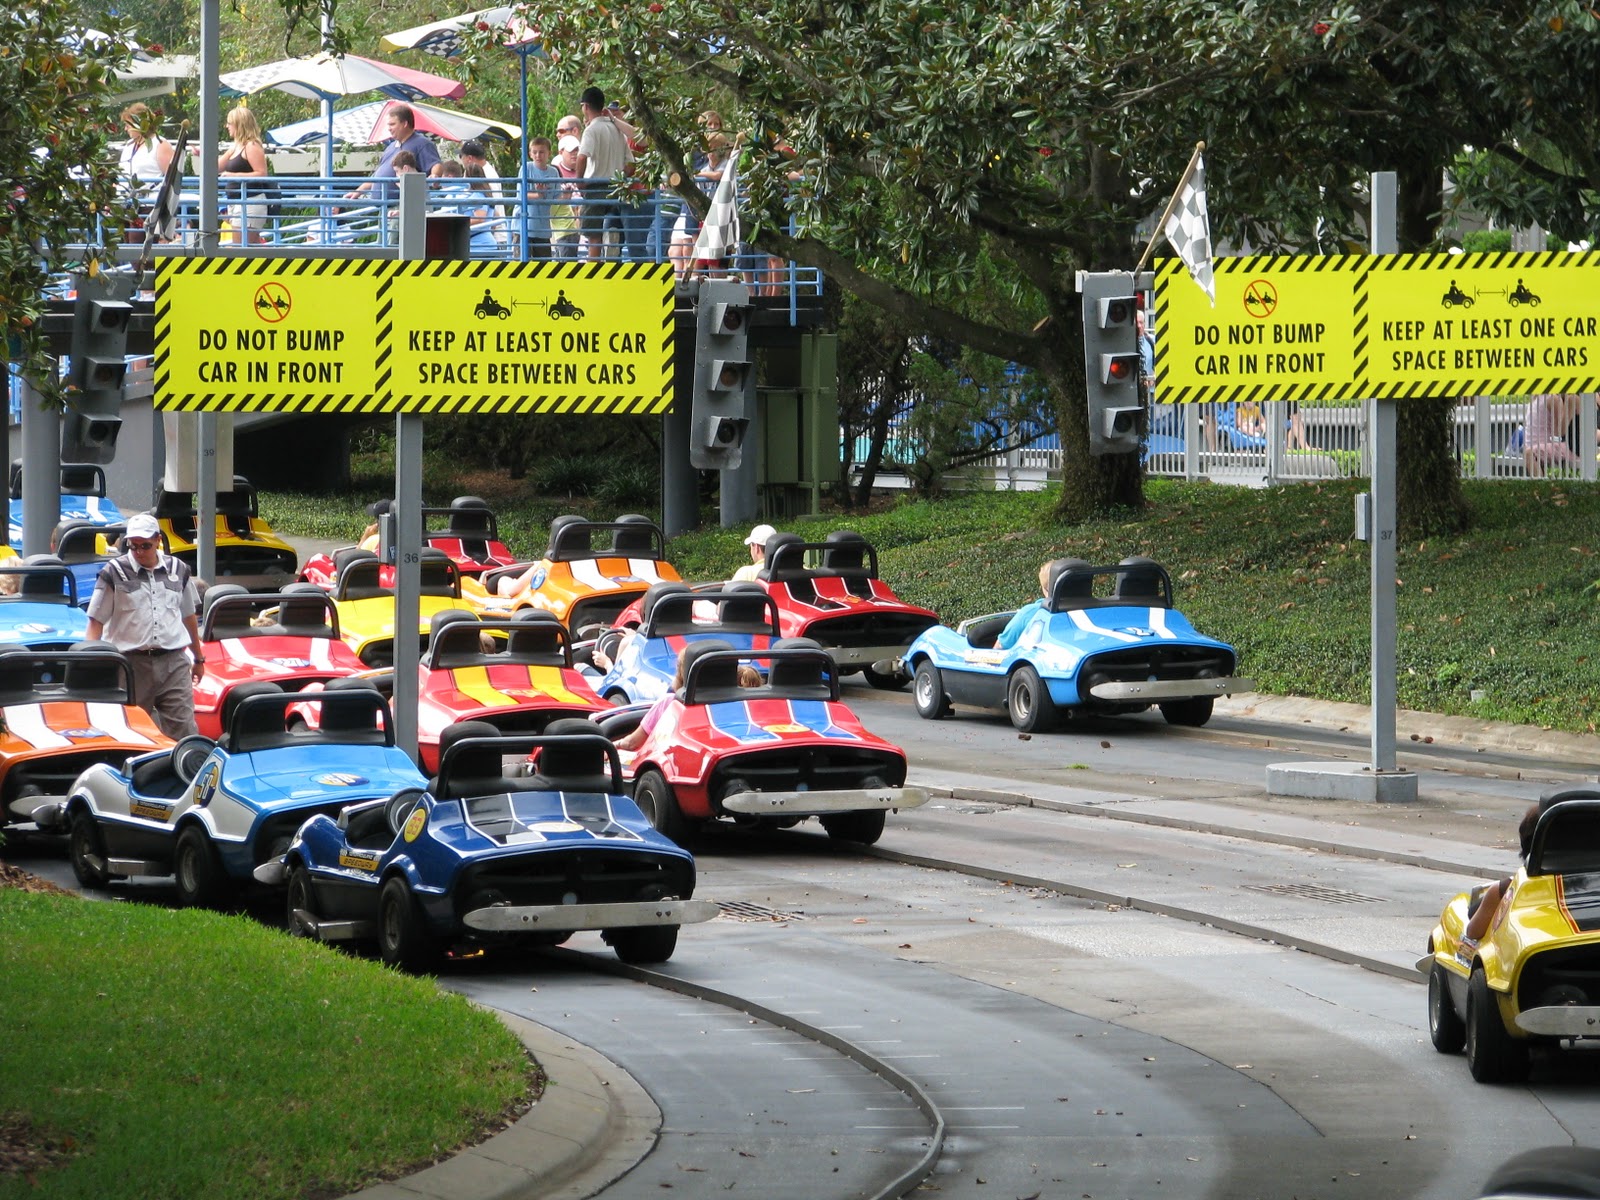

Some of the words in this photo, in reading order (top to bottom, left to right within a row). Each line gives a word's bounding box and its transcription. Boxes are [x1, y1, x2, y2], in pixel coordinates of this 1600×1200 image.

[199, 328, 228, 351] DO
[236, 329, 278, 351] NOT
[286, 329, 345, 352] BUMP
[1194, 324, 1220, 346] DO
[1228, 324, 1265, 345] NOT
[1273, 323, 1326, 344] BUMP
[1383, 320, 1425, 342] KEEP
[1433, 320, 1454, 340] AT
[1461, 318, 1513, 340] LEAST
[1520, 317, 1555, 338] ONE
[1563, 317, 1597, 337] CAR
[408, 330, 456, 352] KEEP
[464, 330, 488, 352] AT
[496, 331, 553, 353] LEAST
[560, 331, 600, 353] ONE
[608, 332, 647, 354] CAR
[1194, 354, 1230, 376] CAR
[1239, 354, 1258, 375] IN
[1266, 352, 1326, 374] FRONT
[1392, 350, 1446, 371] SPACE
[1454, 347, 1535, 370] BETWEEN
[1542, 346, 1588, 367] CARS
[198, 361, 238, 383] CAR
[247, 361, 268, 383] IN
[277, 361, 344, 384] FRONT
[418, 362, 478, 384] SPACE
[487, 363, 577, 385] BETWEEN
[585, 363, 636, 385] CARS
[1381, 530, 1393, 540] 37
[404, 552, 419, 564] 36
